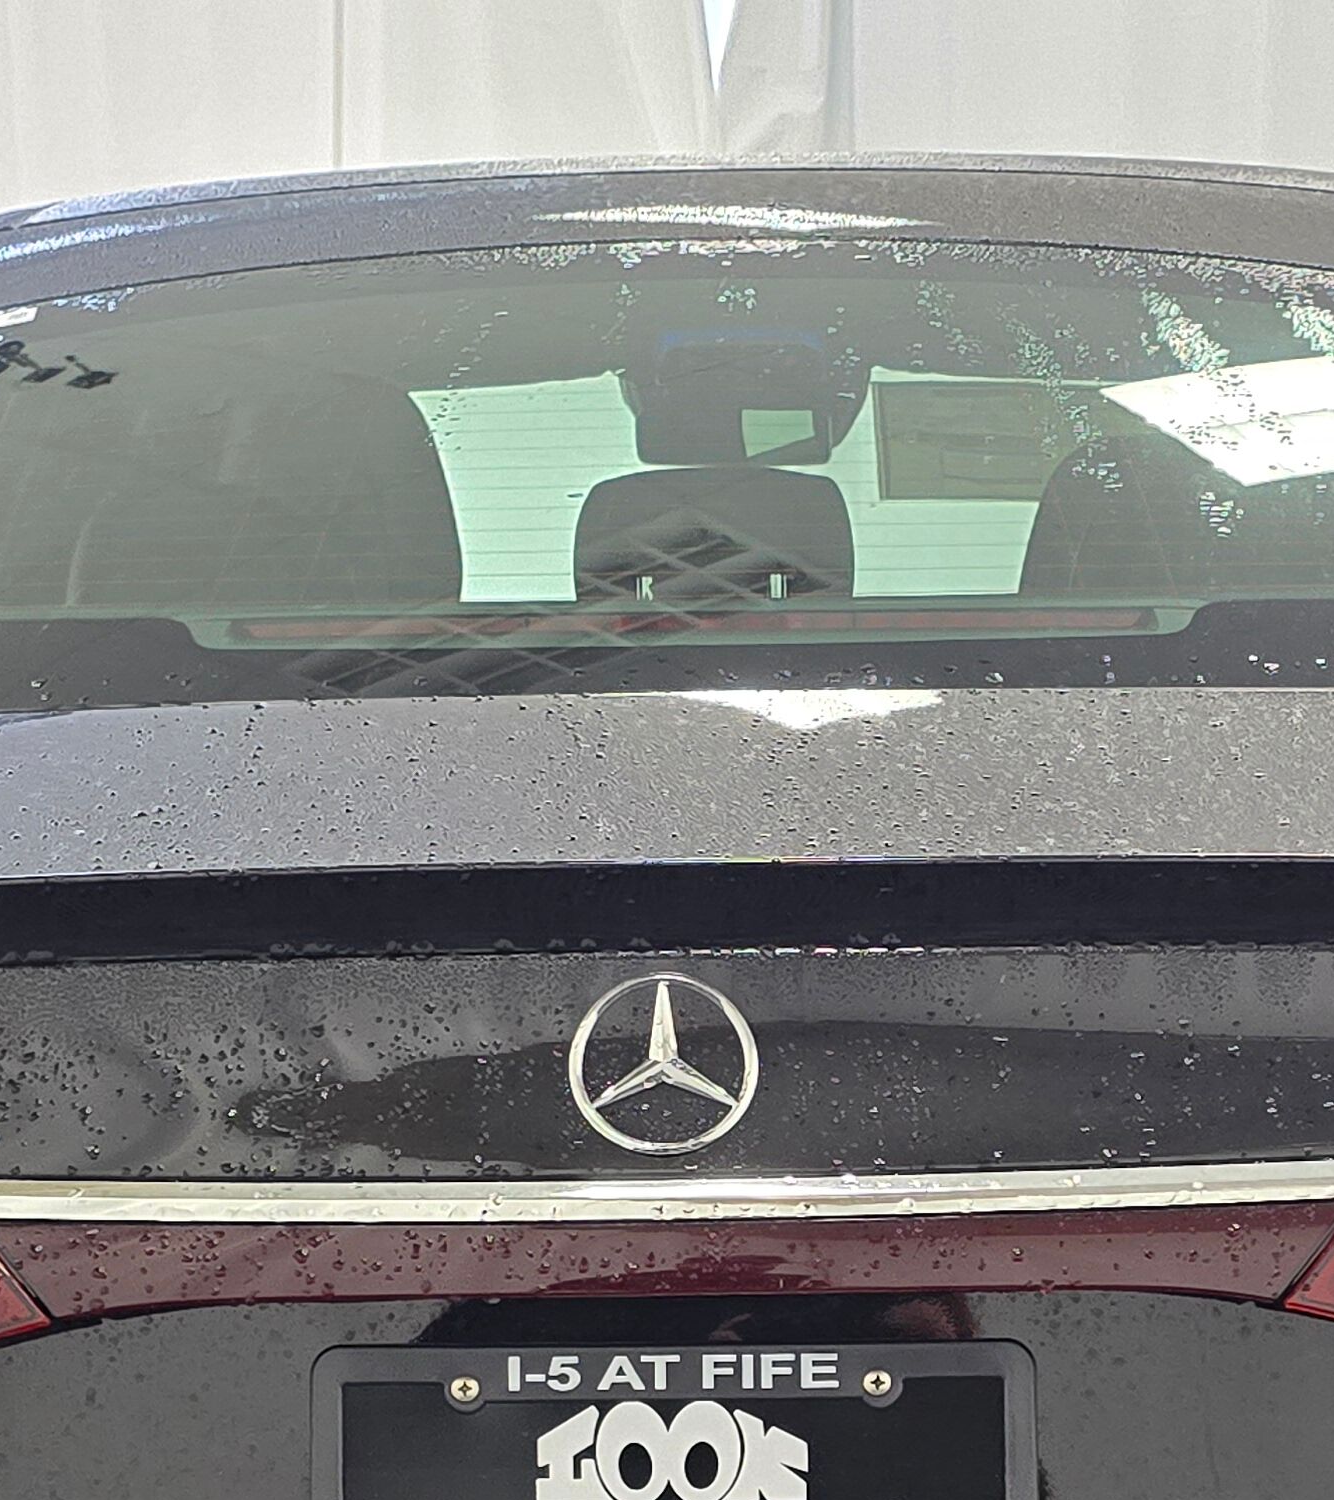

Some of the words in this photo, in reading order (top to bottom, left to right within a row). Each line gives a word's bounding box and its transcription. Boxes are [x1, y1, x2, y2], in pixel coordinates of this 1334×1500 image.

[507, 1355, 582, 1392] I-5
[596, 1354, 681, 1391] AT
[701, 1352, 840, 1390] FIFE
